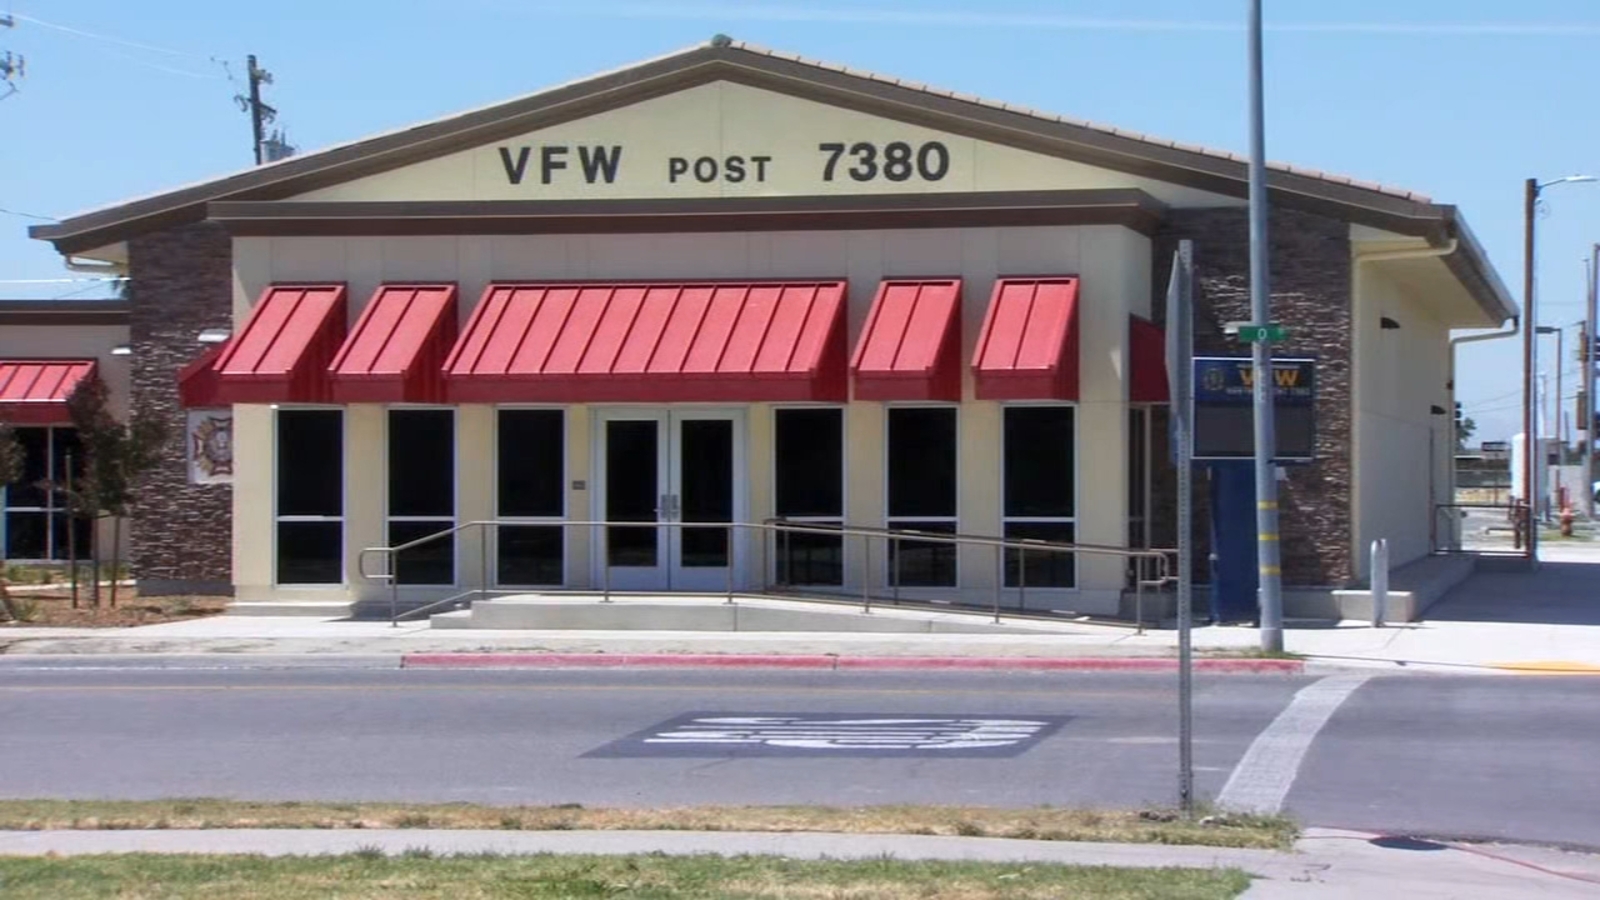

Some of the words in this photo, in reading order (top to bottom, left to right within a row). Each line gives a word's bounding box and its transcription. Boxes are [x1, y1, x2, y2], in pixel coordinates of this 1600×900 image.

[498, 146, 623, 185] VFW
[668, 155, 772, 184] POST
[818, 141, 950, 183] 7380
[1239, 369, 1299, 388] VW
